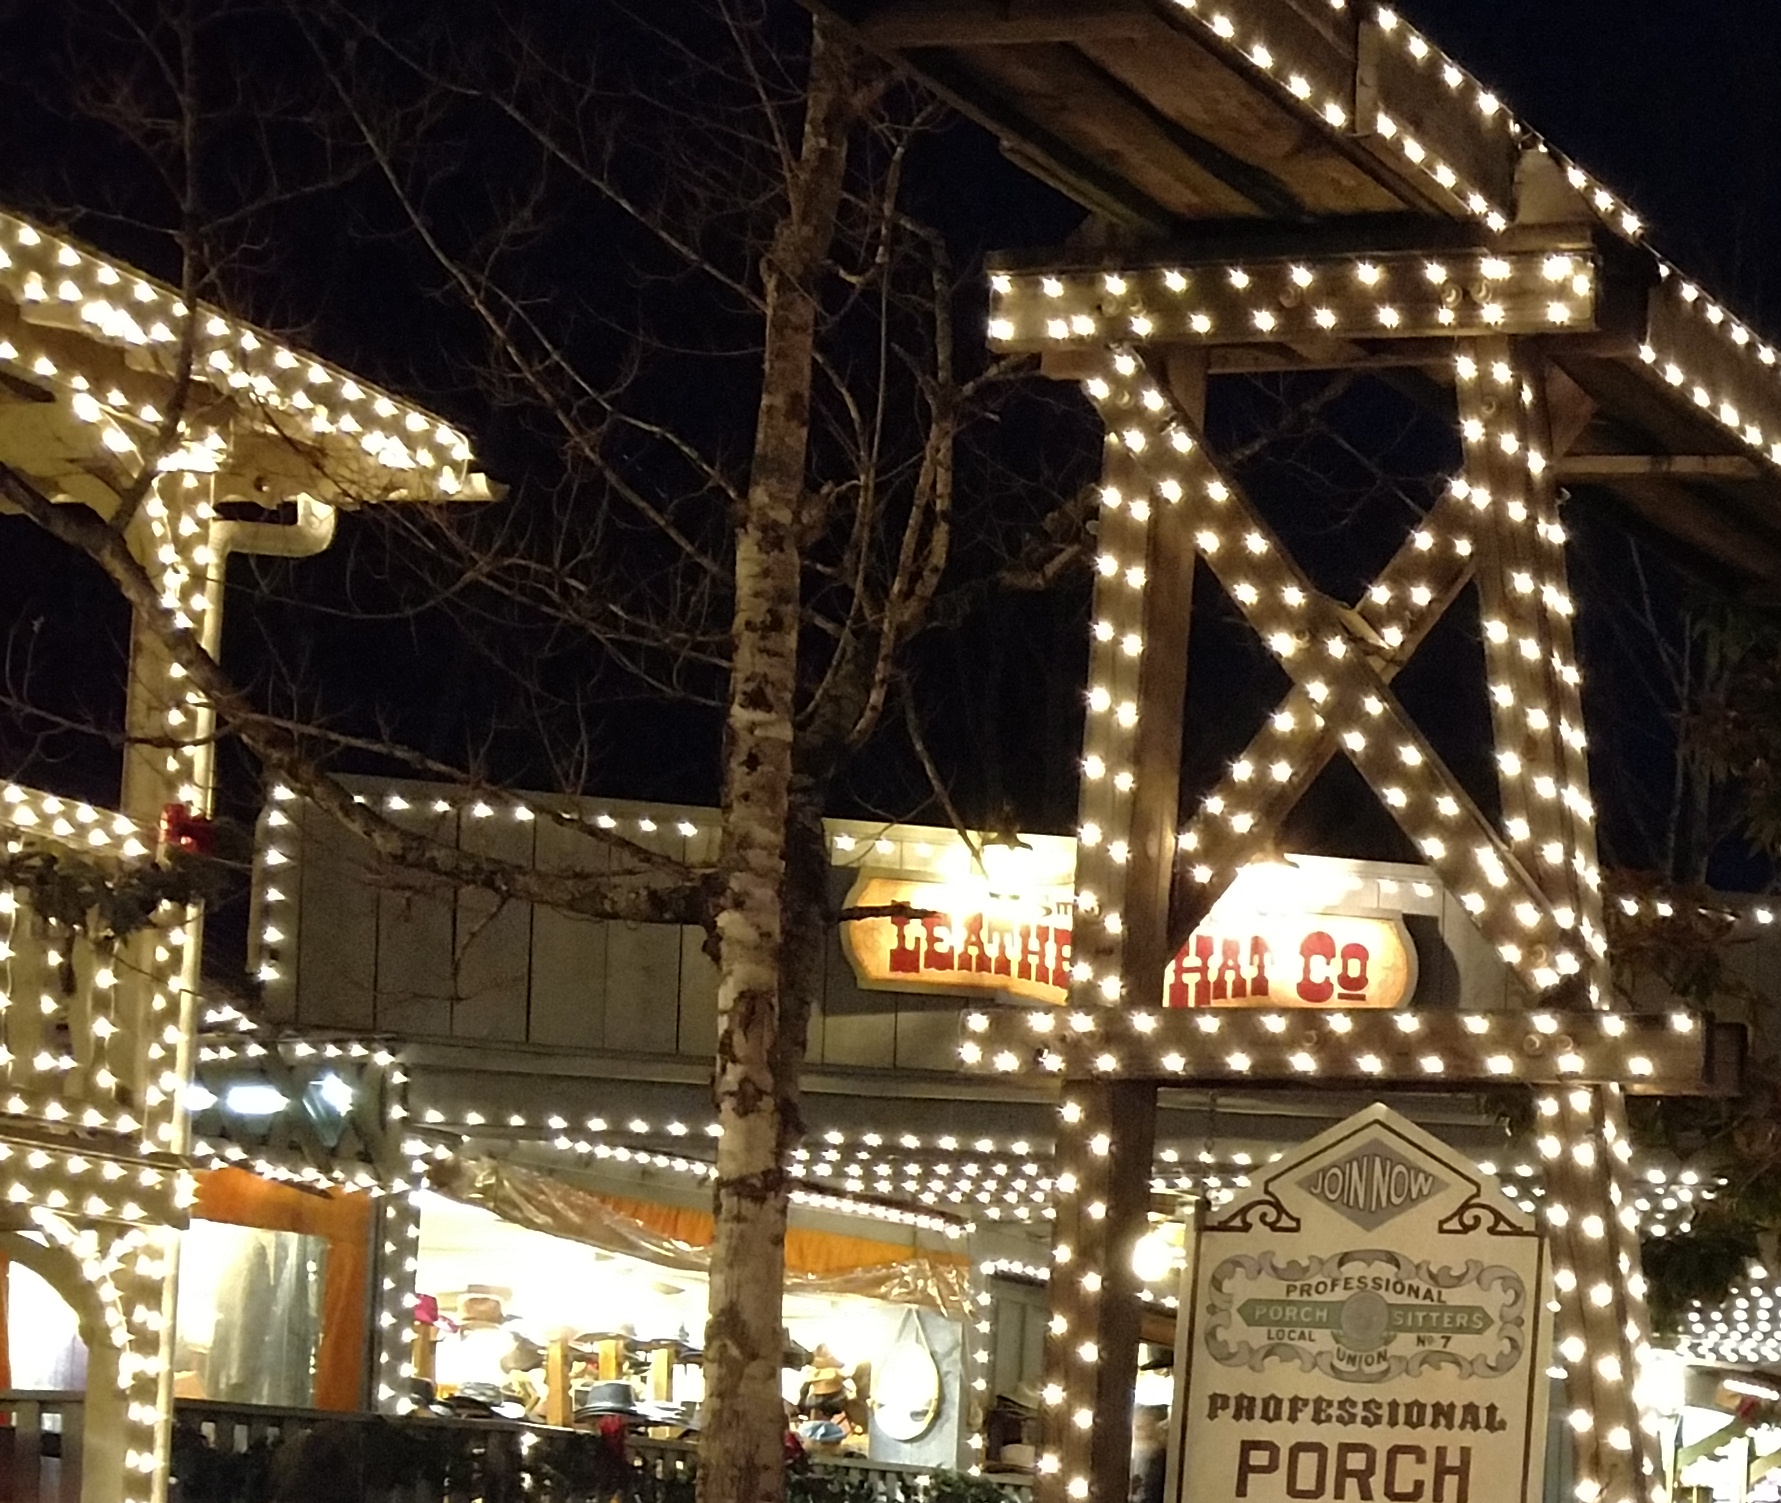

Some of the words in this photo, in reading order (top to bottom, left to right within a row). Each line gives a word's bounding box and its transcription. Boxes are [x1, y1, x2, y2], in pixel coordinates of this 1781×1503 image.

[889, 903, 1071, 991] LEATHE
[1310, 1154, 1368, 1211] JOIN
[1369, 1154, 1433, 1213] NOW
[1286, 1275, 1447, 1303] PROFESSIONAL
[1254, 1304, 1328, 1323] PORCH
[1392, 1310, 1484, 1329] SITTERS
[1266, 1329, 1316, 1342] LOCAL
[1440, 1335, 1452, 1349] 7
[1336, 1347, 1388, 1367] UNION
[1206, 1392, 1507, 1434] PROFESSIONAL
[1235, 1439, 1472, 1503] PORCH
